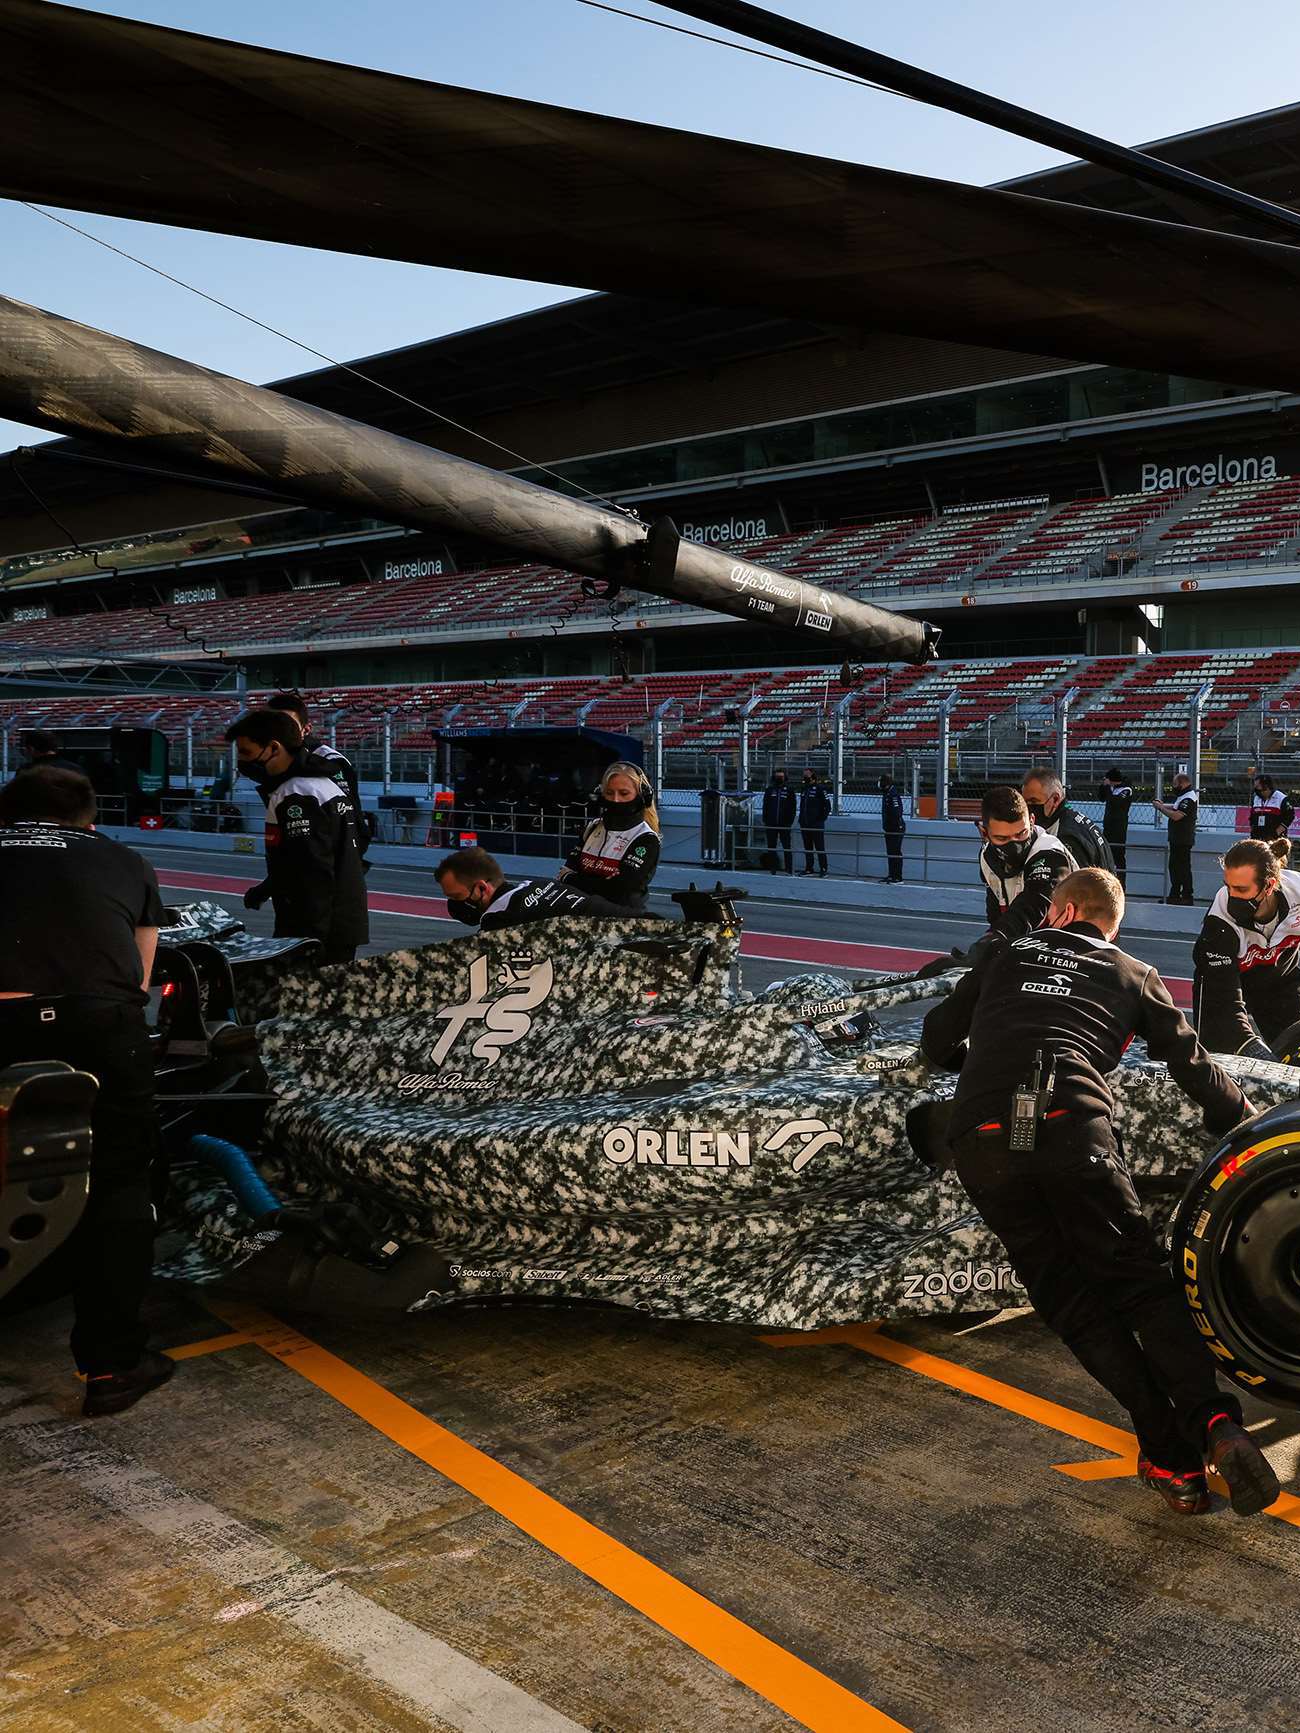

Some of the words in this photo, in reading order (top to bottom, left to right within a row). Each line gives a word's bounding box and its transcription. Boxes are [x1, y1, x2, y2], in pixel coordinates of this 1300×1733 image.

[1141, 454, 1277, 492] Barcelona
[683, 517, 767, 544] Barcelona
[384, 559, 442, 581] Barcelona
[730, 565, 760, 592] Alfa
[758, 572, 797, 600] Romeo
[173, 584, 216, 605] Barcelona
[13, 607, 48, 621] Barcelona
[748, 597, 758, 609] F1
[757, 599, 775, 614] TEAM
[807, 612, 831, 630] ORLEN
[440, 727, 467, 738] WILLIAMS
[1037, 954, 1051, 964] F1
[1051, 956, 1078, 970] TEAM
[1024, 983, 1067, 995] ORLEN
[800, 998, 846, 1020] Hyland
[867, 1059, 899, 1070] ORLEN
[397, 1073, 439, 1096] Alfa
[437, 1072, 500, 1090] Romeo
[602, 1126, 752, 1168] ORLEN
[1183, 1247, 1236, 1361] ZERO
